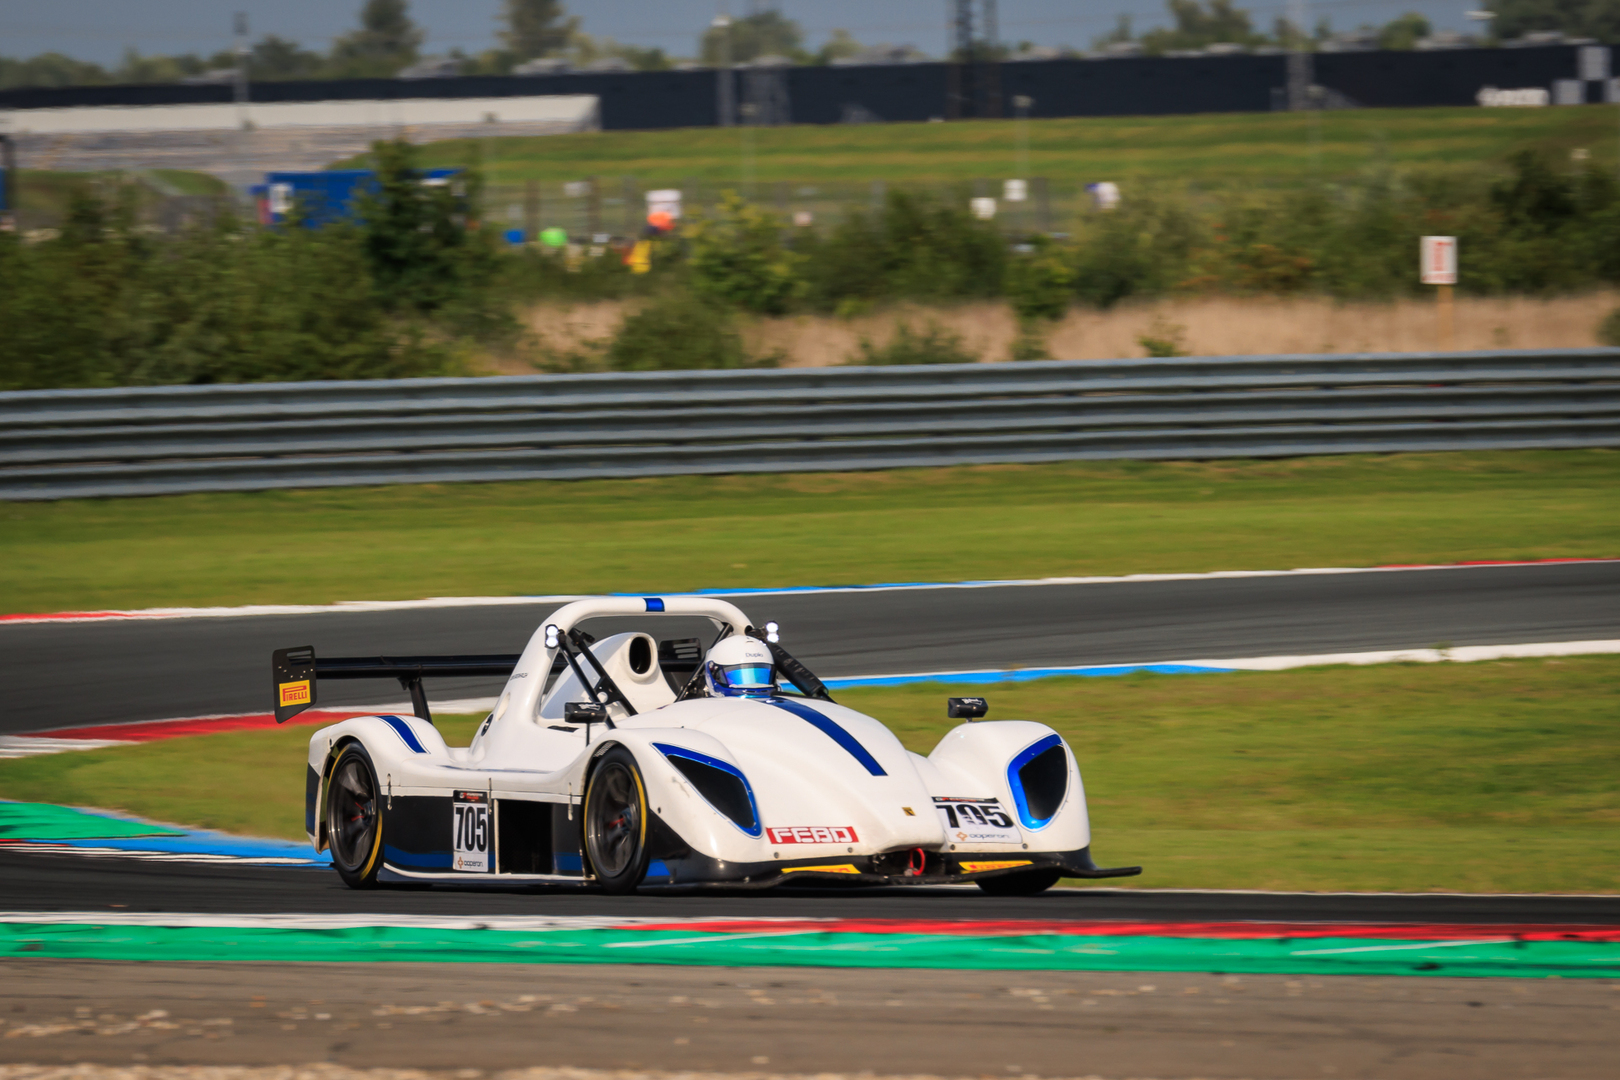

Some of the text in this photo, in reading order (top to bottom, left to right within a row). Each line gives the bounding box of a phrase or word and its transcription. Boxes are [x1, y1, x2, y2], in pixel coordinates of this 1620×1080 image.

[282, 685, 308, 702] PIRELLI
[455, 805, 487, 852] 705
[771, 827, 853, 843] FEBO
